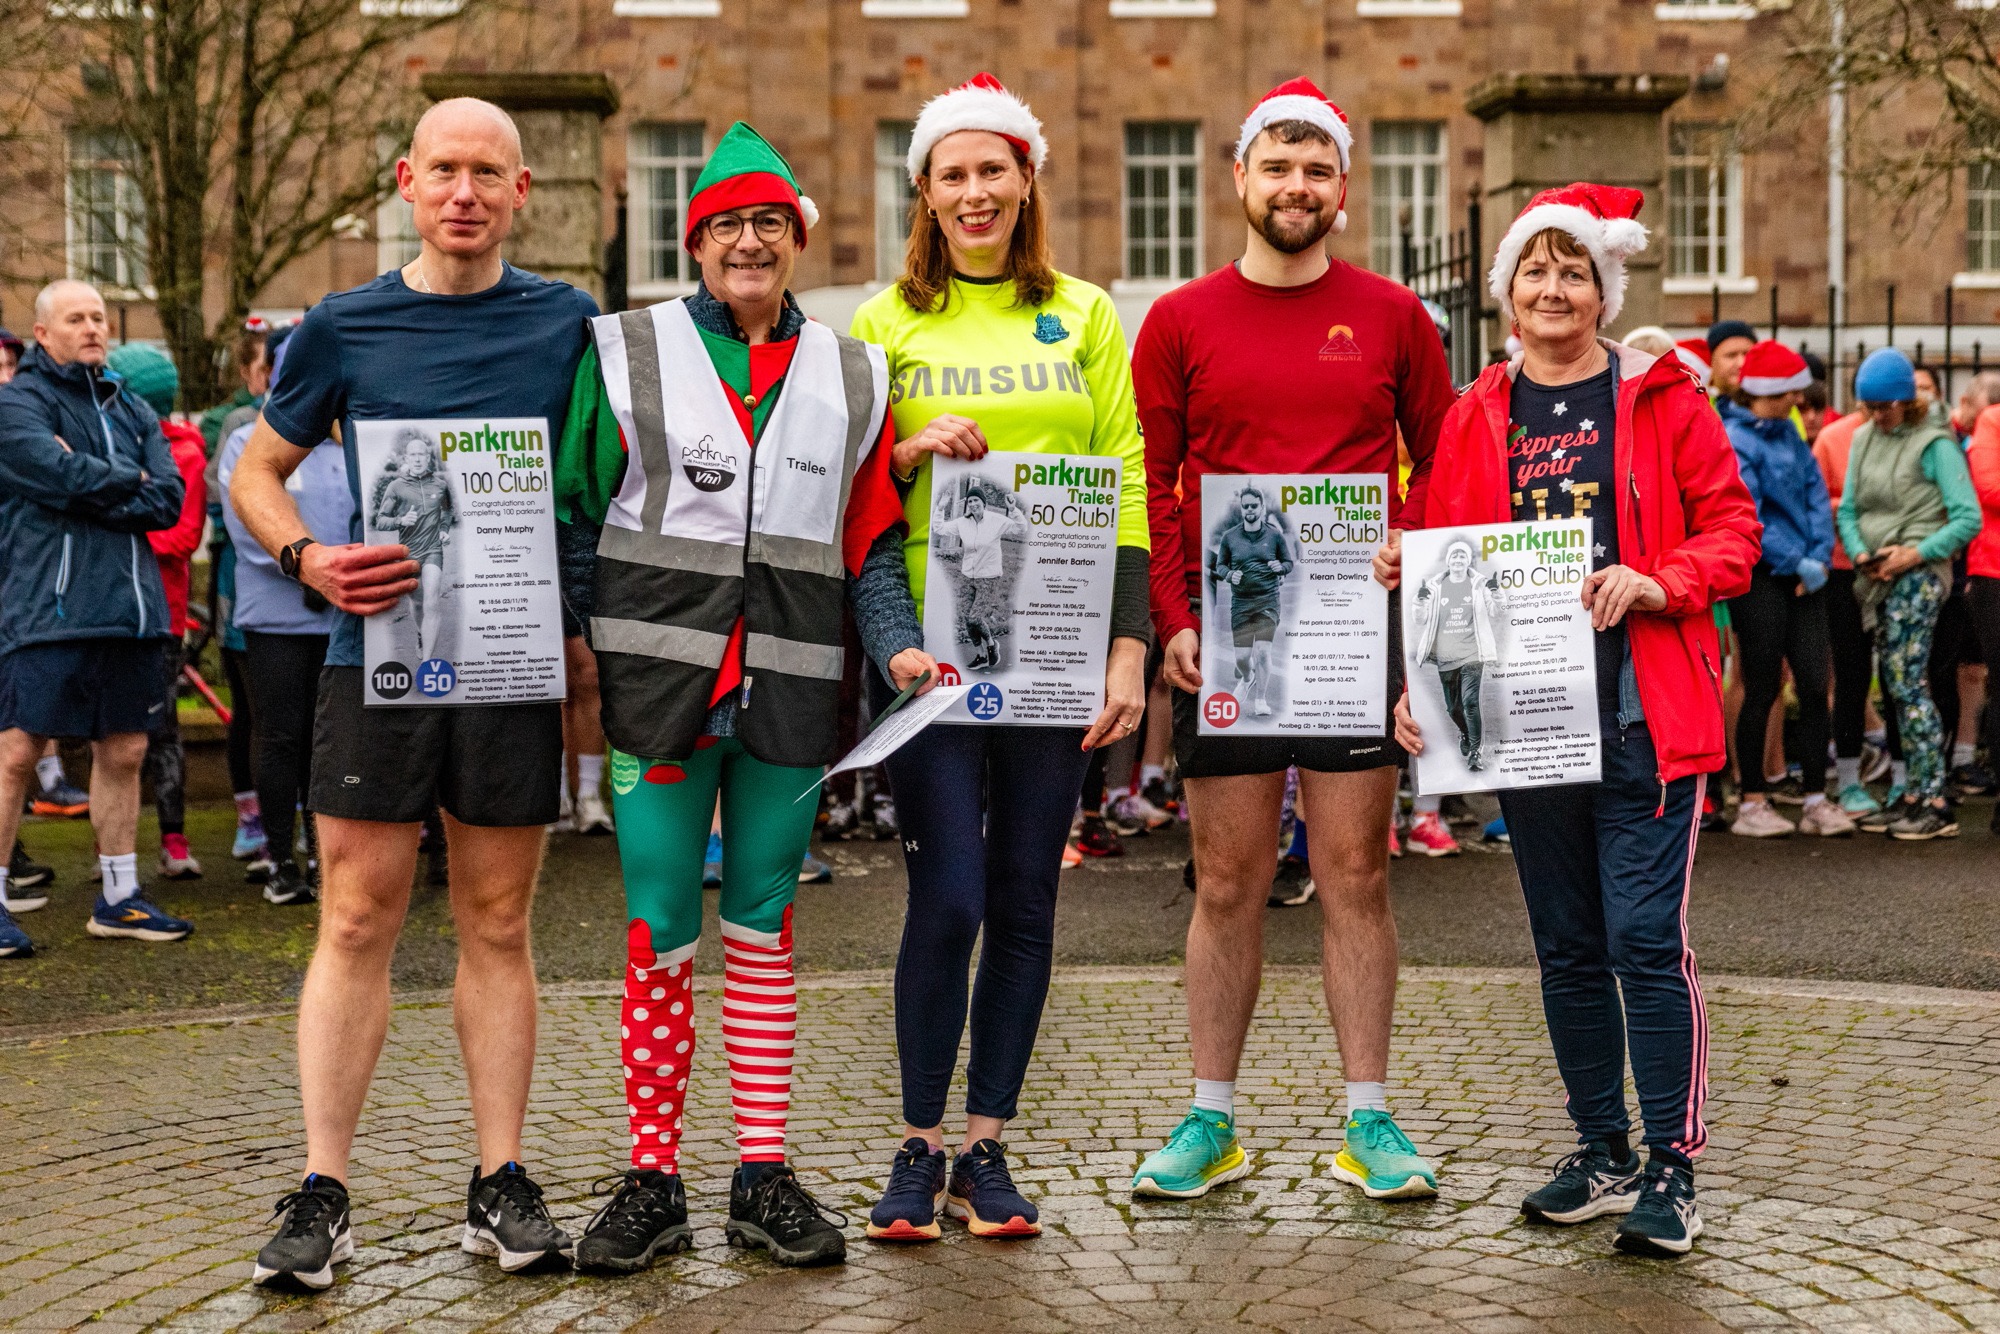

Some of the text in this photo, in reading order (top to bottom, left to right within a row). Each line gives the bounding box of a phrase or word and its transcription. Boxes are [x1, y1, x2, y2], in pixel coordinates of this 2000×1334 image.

[440, 423, 543, 461] parkrun
[1509, 430, 1599, 461] Express
[496, 453, 544, 468] Tralee
[682, 439, 736, 466] parkrun
[786, 457, 826, 476] Tralee
[1517, 456, 1582, 488] your
[462, 471, 547, 493] 100 Club!
[695, 471, 720, 484] Vhi
[1014, 458, 1116, 492] parkrun
[1068, 489, 1114, 505] Tralee
[1282, 478, 1381, 512] parkrun
[1031, 504, 1114, 528] 50 Club!
[1334, 506, 1381, 520] Tralee
[505, 526, 534, 534] Murphy
[1037, 532, 1089, 540] Congratulations
[1300, 523, 1383, 543] 50 Club!
[1482, 526, 1584, 561] parkrun
[1536, 550, 1584, 564] Tralee
[1338, 573, 1368, 581] Dowling
[1501, 569, 1524, 589] 50
[1509, 592, 1561, 601] Congratulations
[1501, 602, 1539, 610] completing
[1537, 614, 1572, 623] Connolly
[430, 662, 441, 672] V
[374, 673, 408, 689] 100
[424, 674, 451, 692] 50
[980, 685, 990, 695] V
[974, 697, 998, 714] 25
[1208, 702, 1236, 720] 50
[1350, 746, 1381, 755] patagonia
